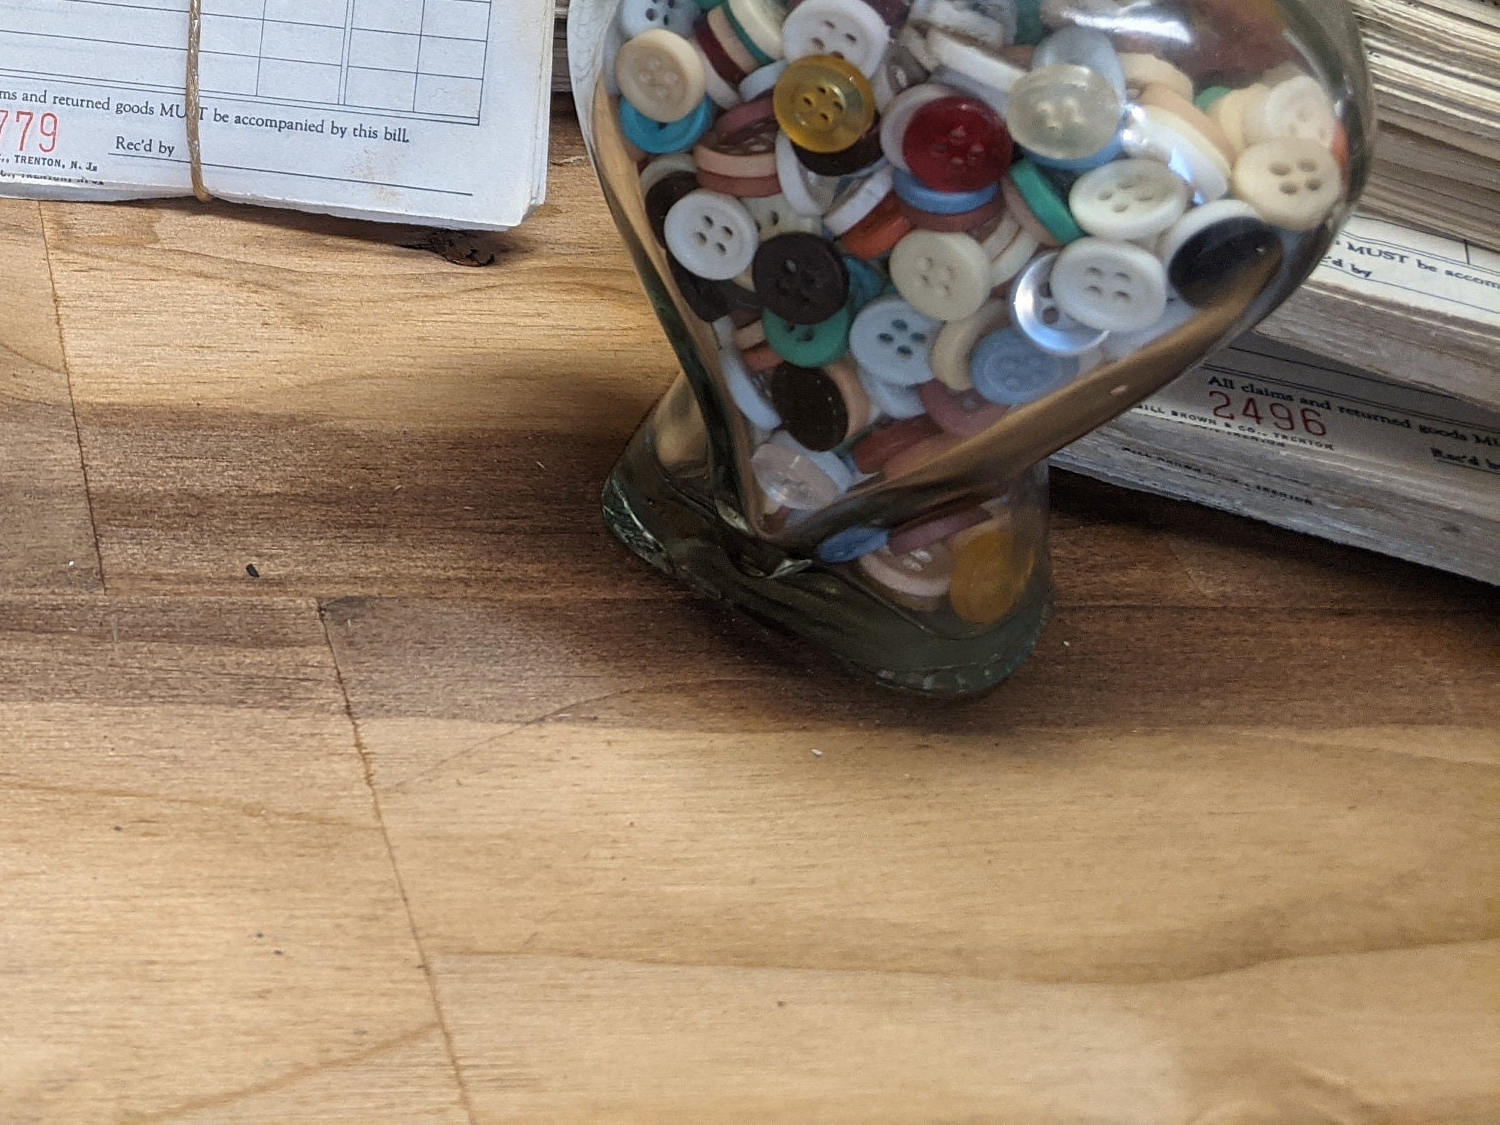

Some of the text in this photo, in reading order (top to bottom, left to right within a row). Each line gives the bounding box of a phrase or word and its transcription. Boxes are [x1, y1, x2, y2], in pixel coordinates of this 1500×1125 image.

[22, 88, 47, 104] and
[52, 94, 110, 111] returned
[116, 100, 154, 116] goods
[160, 103, 208, 121] MUT
[213, 108, 229, 123] be
[234, 114, 324, 134] accompanied
[330, 121, 347, 138] by
[353, 124, 378, 139] this
[14, 154, 66, 170] TRENTON,
[115, 135, 176, 157] Rec'd by
[1347, 241, 1438, 272] MUST be
[1208, 376, 1412, 429] All claims and returned
[1208, 390, 1327, 437] 2496
